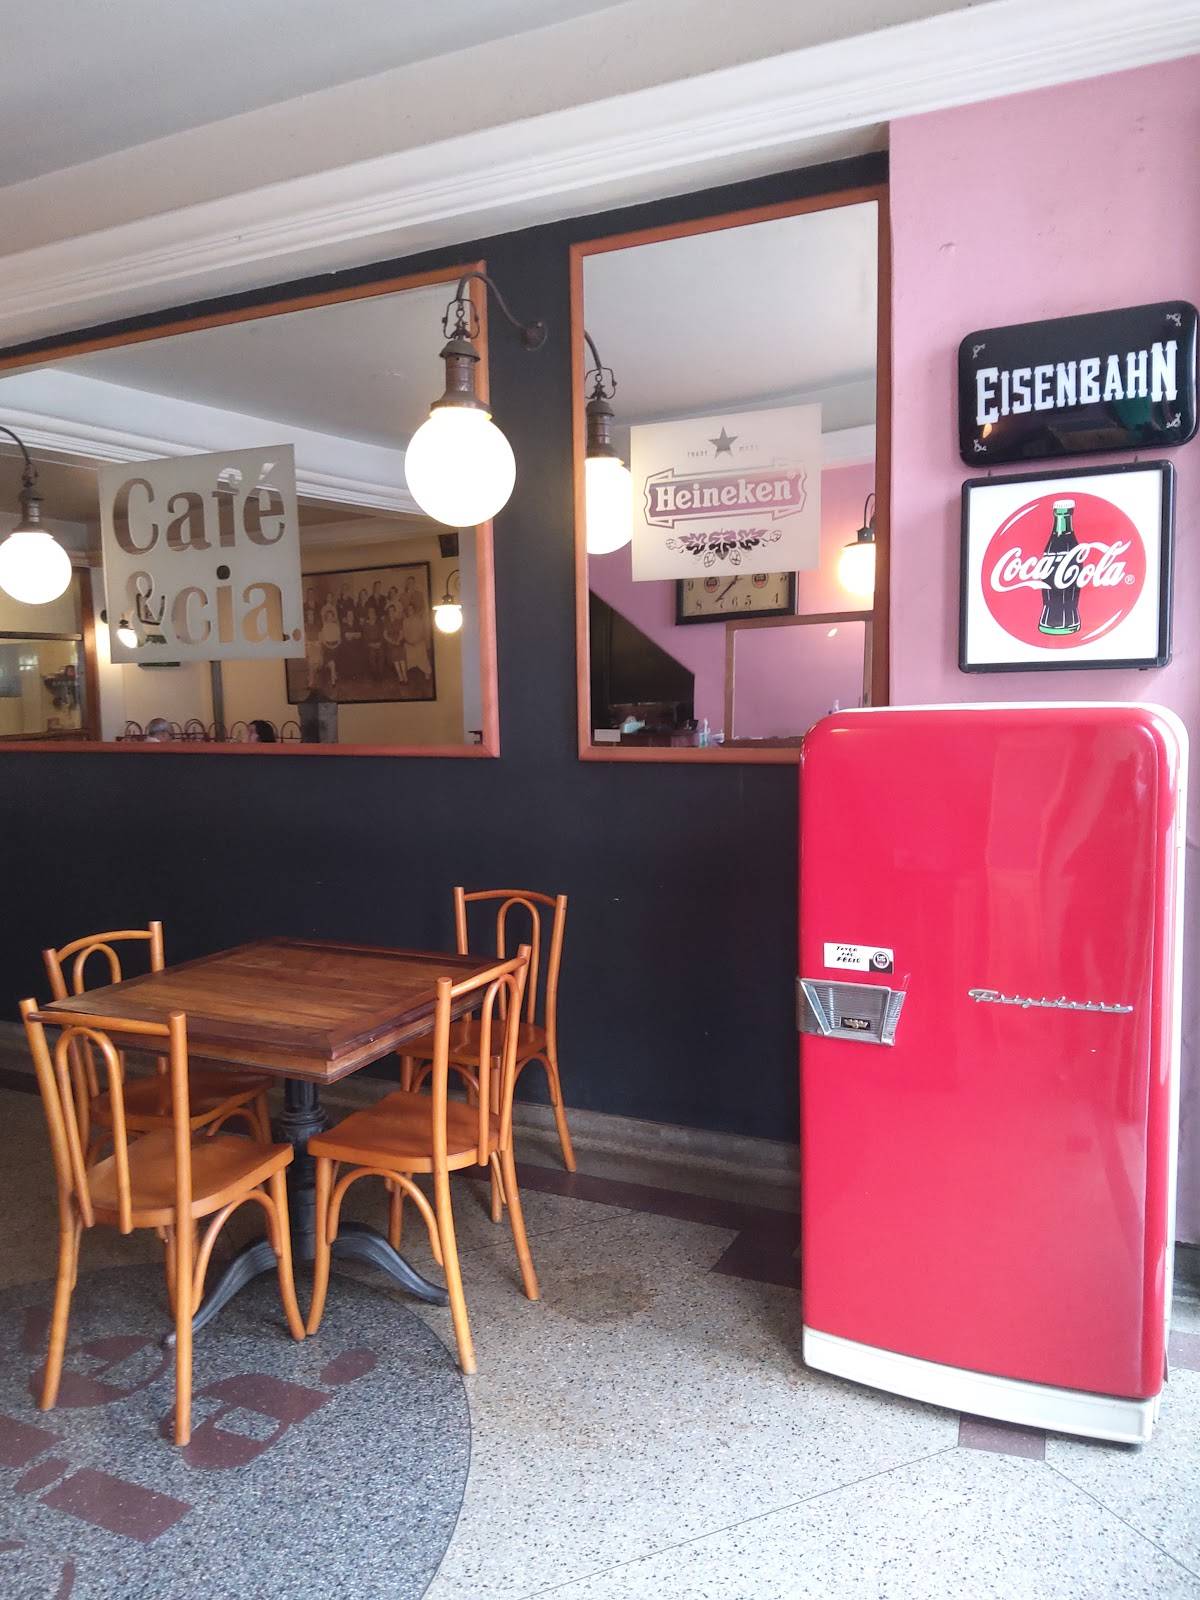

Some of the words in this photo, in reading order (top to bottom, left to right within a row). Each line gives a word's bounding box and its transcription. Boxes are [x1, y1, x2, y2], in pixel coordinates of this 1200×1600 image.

[976, 340, 1178, 426] EISENBAHN
[113, 461, 286, 555] Café
[655, 478, 793, 512] Heineken
[990, 540, 1132, 592] Coca-Cola
